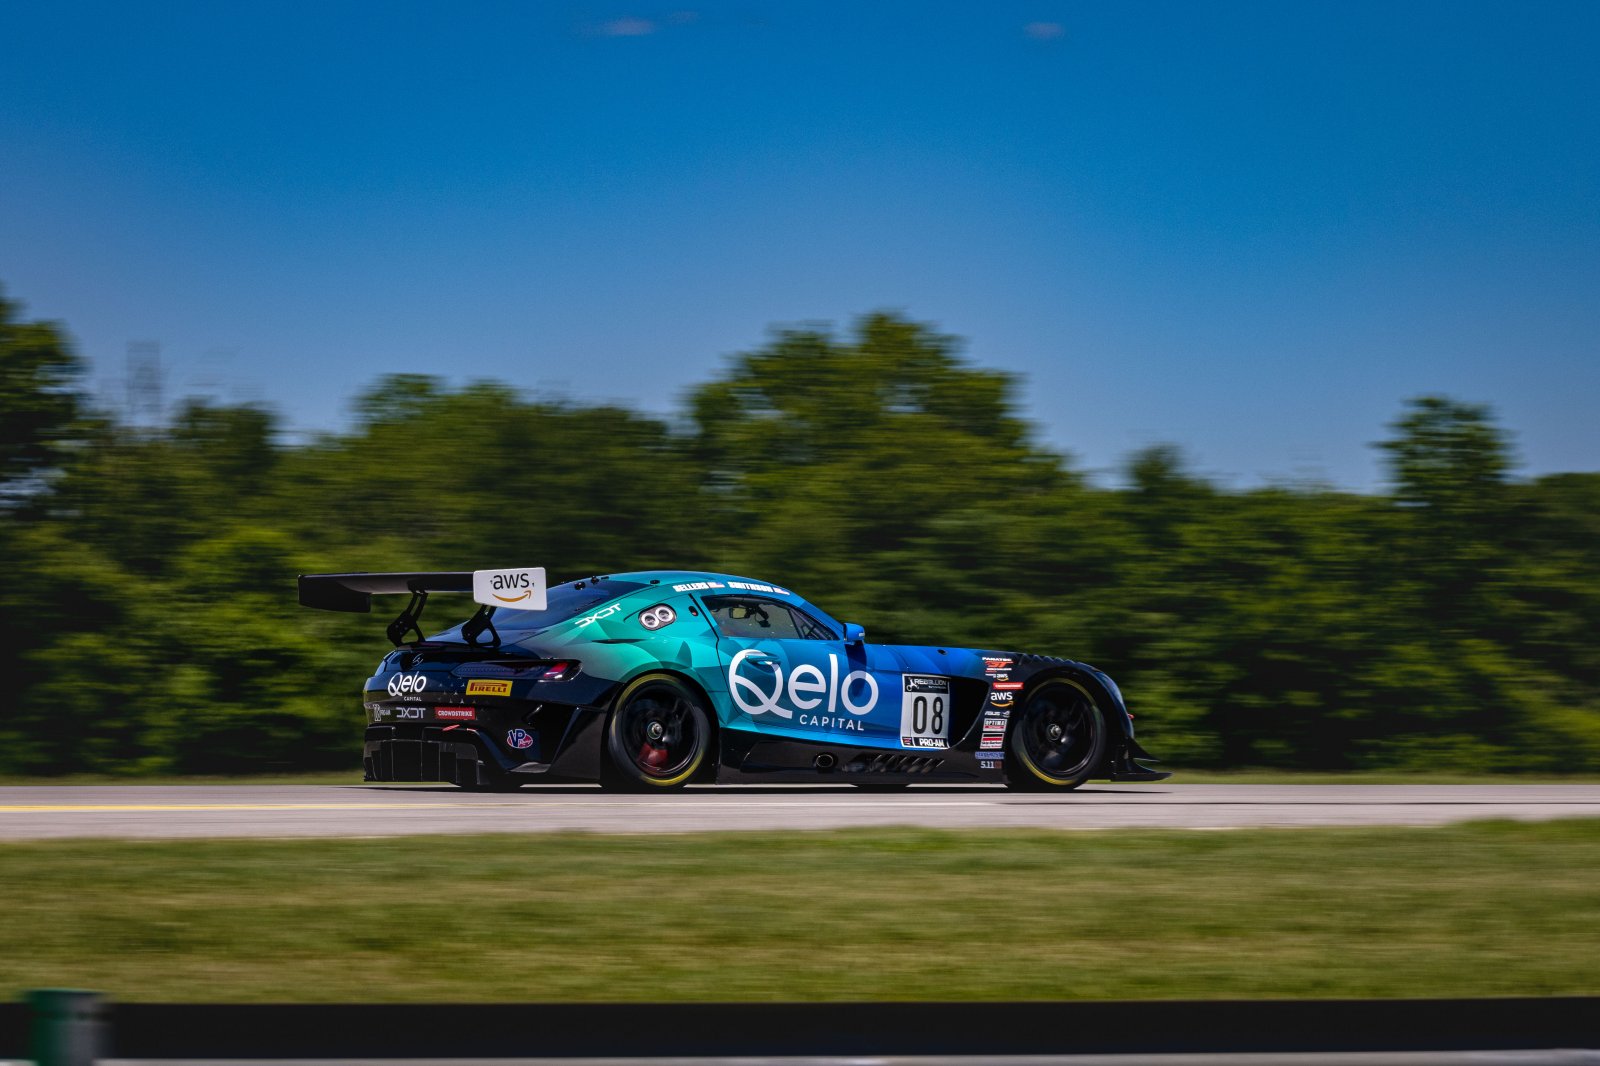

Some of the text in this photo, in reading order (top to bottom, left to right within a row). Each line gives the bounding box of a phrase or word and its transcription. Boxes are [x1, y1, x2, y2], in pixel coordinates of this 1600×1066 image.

[493, 573, 530, 590] aws
[388, 671, 427, 697] Qelo
[470, 682, 508, 693] PIRELLI
[729, 649, 879, 719] Qelo
[991, 692, 1013, 701] aws
[800, 714, 865, 732] CAPITAL
[913, 696, 944, 735] 08
